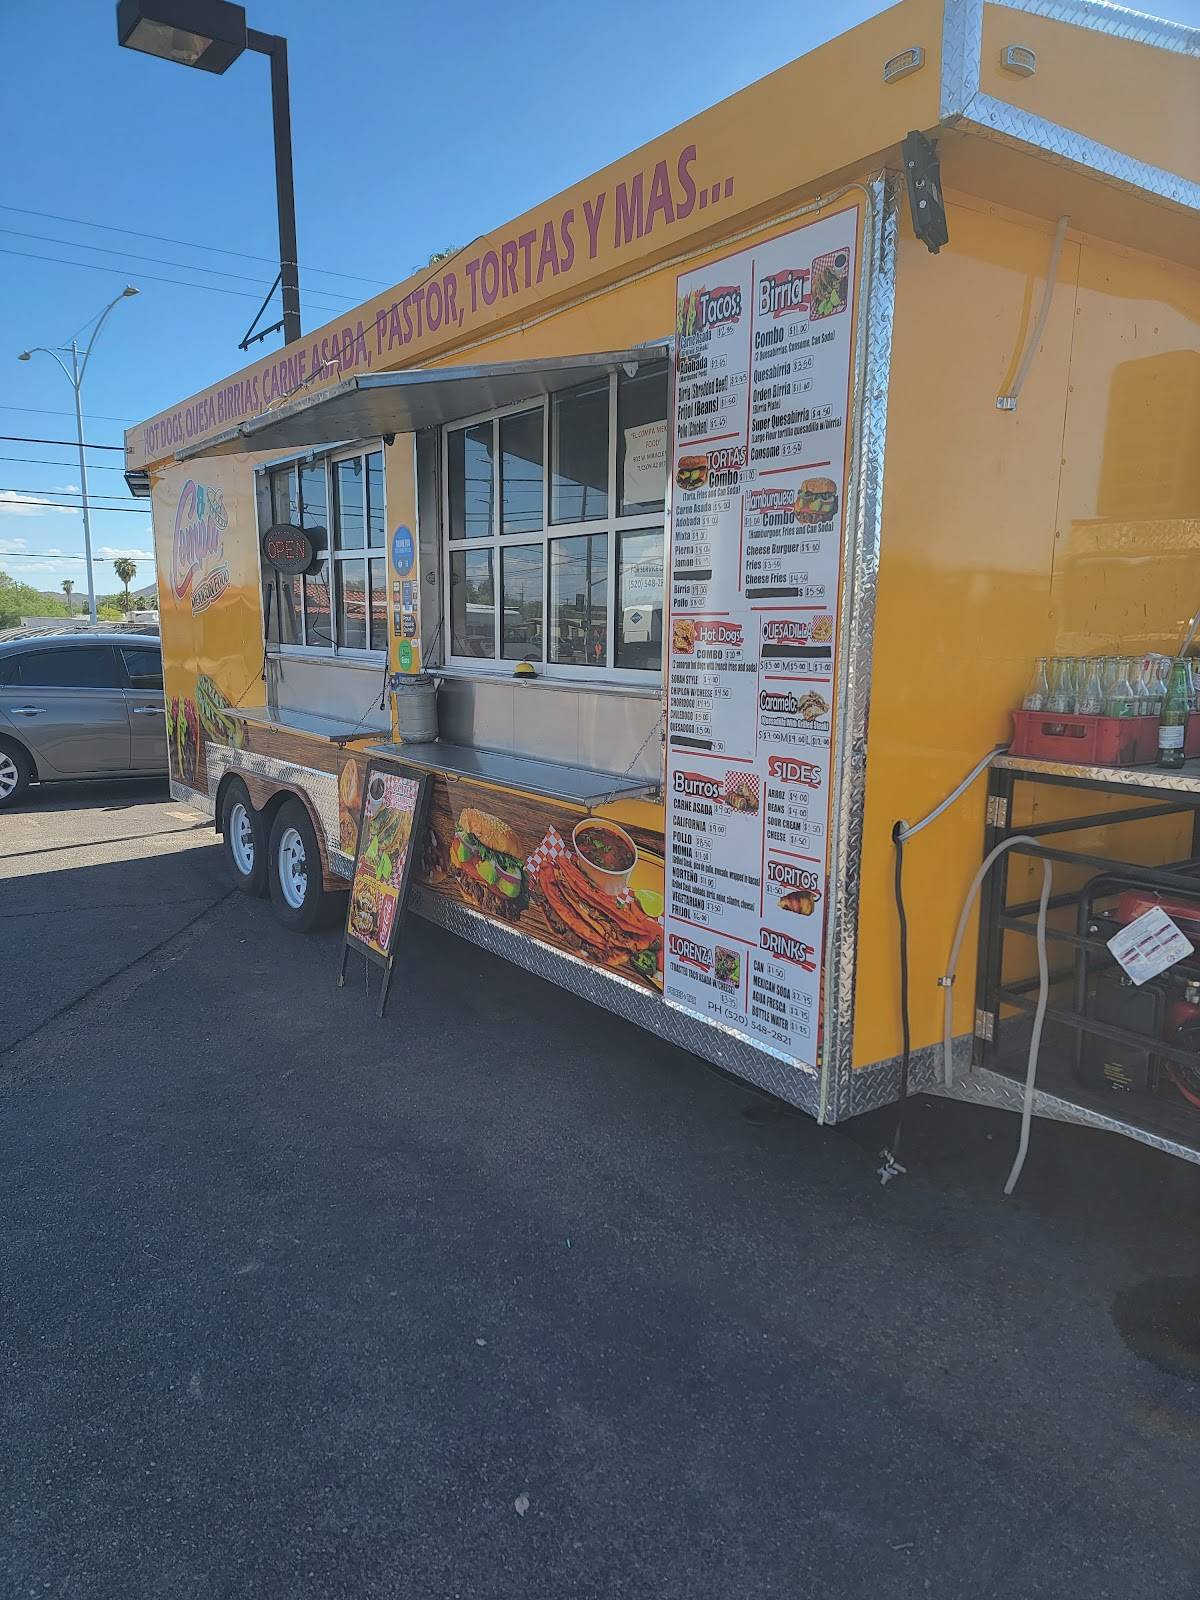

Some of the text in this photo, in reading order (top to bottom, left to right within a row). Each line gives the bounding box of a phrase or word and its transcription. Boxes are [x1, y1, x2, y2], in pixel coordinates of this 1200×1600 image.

[143, 144, 734, 457] HOT DOGS, QUESA BIRRIAS, CARNE ASADA, PASTOR, TORTAS Y MAS...
[759, 271, 804, 316] Birria
[700, 291, 741, 326] Tacos:
[755, 326, 784, 349] Combo
[753, 361, 791, 385] Quesabirria
[753, 381, 791, 402] Orden Birria
[751, 407, 810, 432] Super Quesabirria
[706, 447, 747, 471] TORTAS
[750, 445, 780, 460] Consome
[709, 469, 739, 488] Combo
[693, 502, 712, 513] Asada
[762, 510, 795, 527] Combo
[267, 540, 306, 559] OPEN
[746, 545, 771, 556] Cheese
[771, 543, 800, 555] Burguer
[745, 560, 762, 570] Fries
[745, 574, 769, 585] Cheese
[770, 572, 787, 583] Fries
[700, 626, 741, 643] Hot Dogs
[762, 622, 813, 642] QUESADILLA
[696, 649, 723, 659] COMBO
[772, 761, 822, 785] SIDES
[674, 771, 720, 798] Burros
[767, 788, 786, 800] ARROZ
[673, 798, 692, 811] CARNE
[692, 801, 713, 816] ASADA
[767, 802, 785, 814] BEANS
[672, 815, 706, 832] CALIFORNIA
[767, 816, 782, 827] SOUR
[782, 819, 801, 831] CREAM
[672, 831, 692, 845] POLLO
[767, 830, 786, 842] CHEESE
[672, 843, 693, 858] MOMIA
[768, 862, 819, 891] TORITOS
[672, 904, 691, 919] FRIJOL
[671, 936, 714, 967] LORENZA
[760, 930, 807, 962] DRINKS
[753, 960, 764, 973] CAN
[752, 975, 776, 994] MEXICAN
[776, 983, 791, 1001] SODA
[752, 990, 766, 1006] AGUA
[766, 996, 786, 1014] FRESCA
[708, 1000, 722, 1015] PH
[724, 1007, 749, 1027] (520)
[751, 1020, 792, 1046] 548-2821
[751, 1005, 770, 1022] BOTTLE
[770, 1015, 789, 1031] WATER
